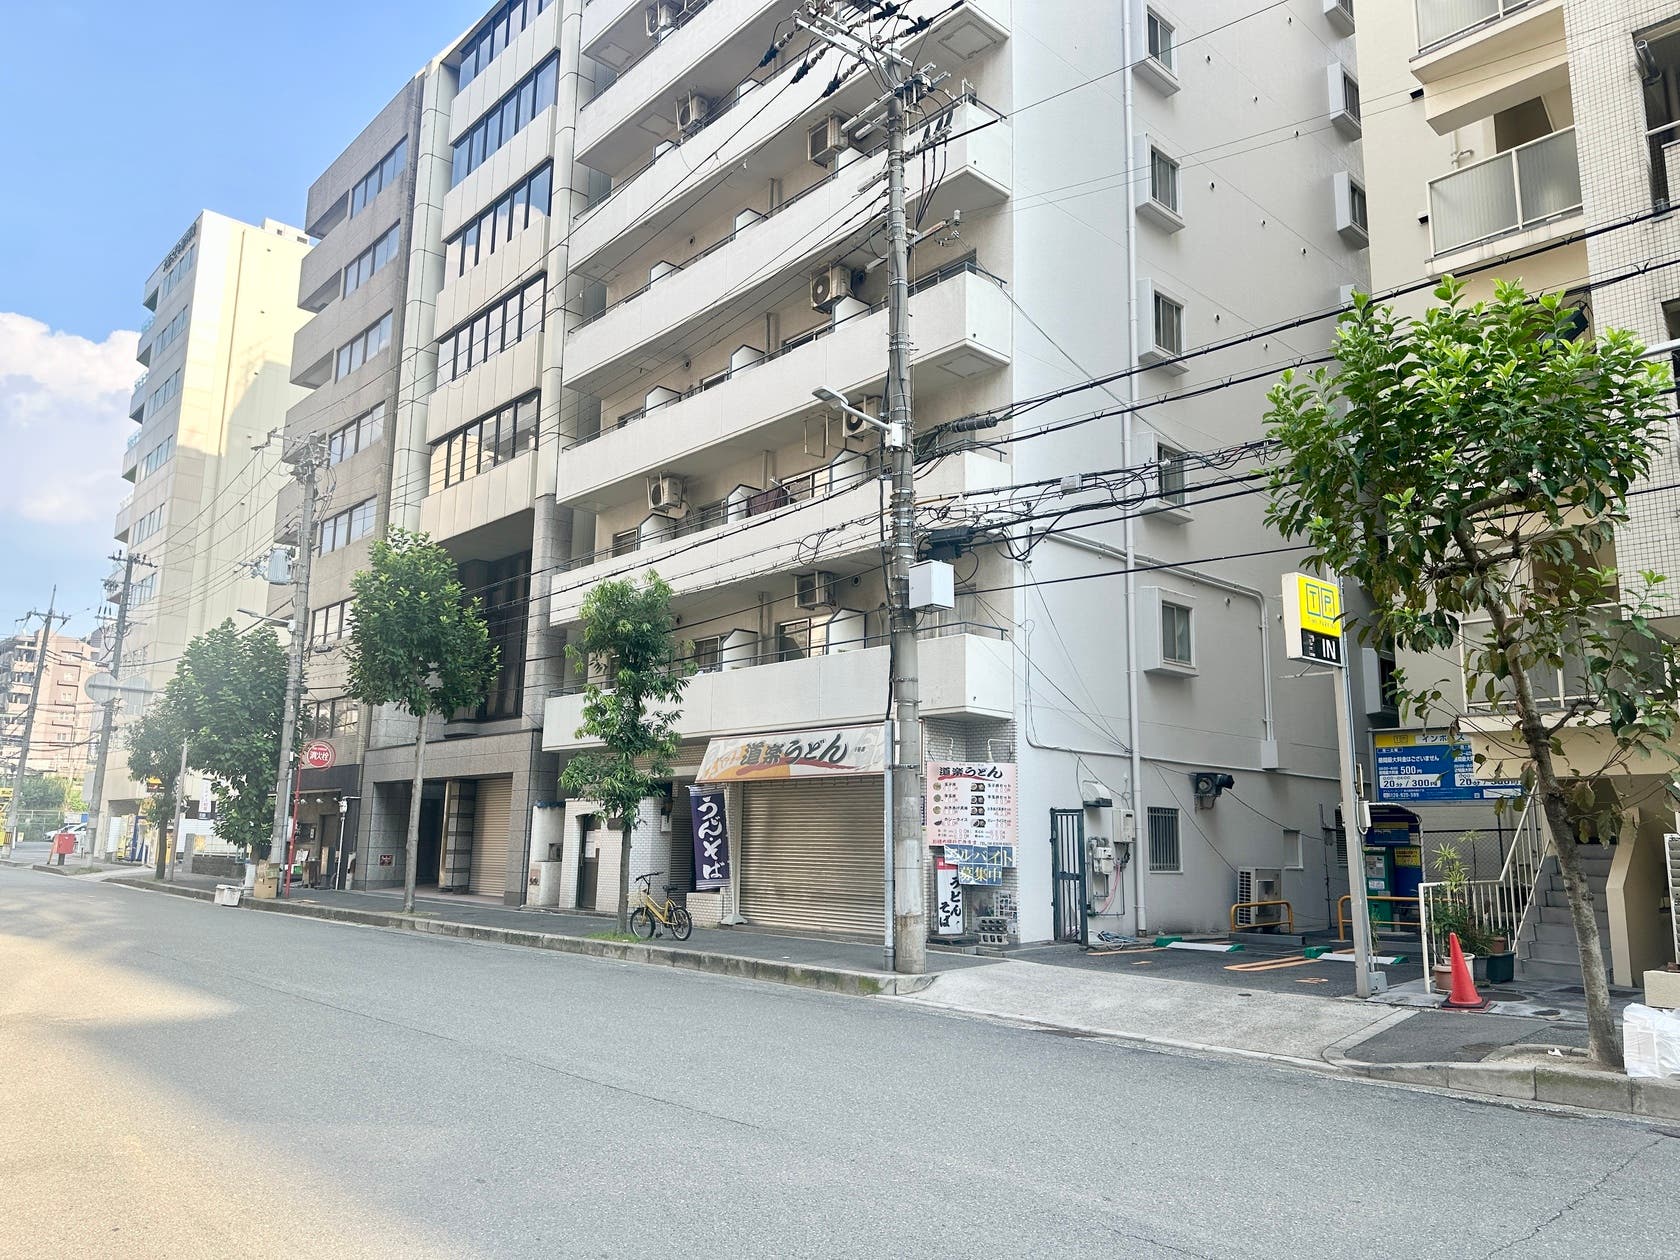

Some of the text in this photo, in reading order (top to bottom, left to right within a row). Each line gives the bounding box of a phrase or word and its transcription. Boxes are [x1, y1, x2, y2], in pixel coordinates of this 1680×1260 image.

[1322, 638, 1336, 659] IN
[309, 751, 329, 761] 消火栓
[741, 733, 848, 765] 道楽うどん
[939, 766, 1003, 779] 道楽うどん
[1400, 765, 1422, 774] 500円
[960, 866, 1002, 883] 募集中
[940, 901, 951, 927] そば
